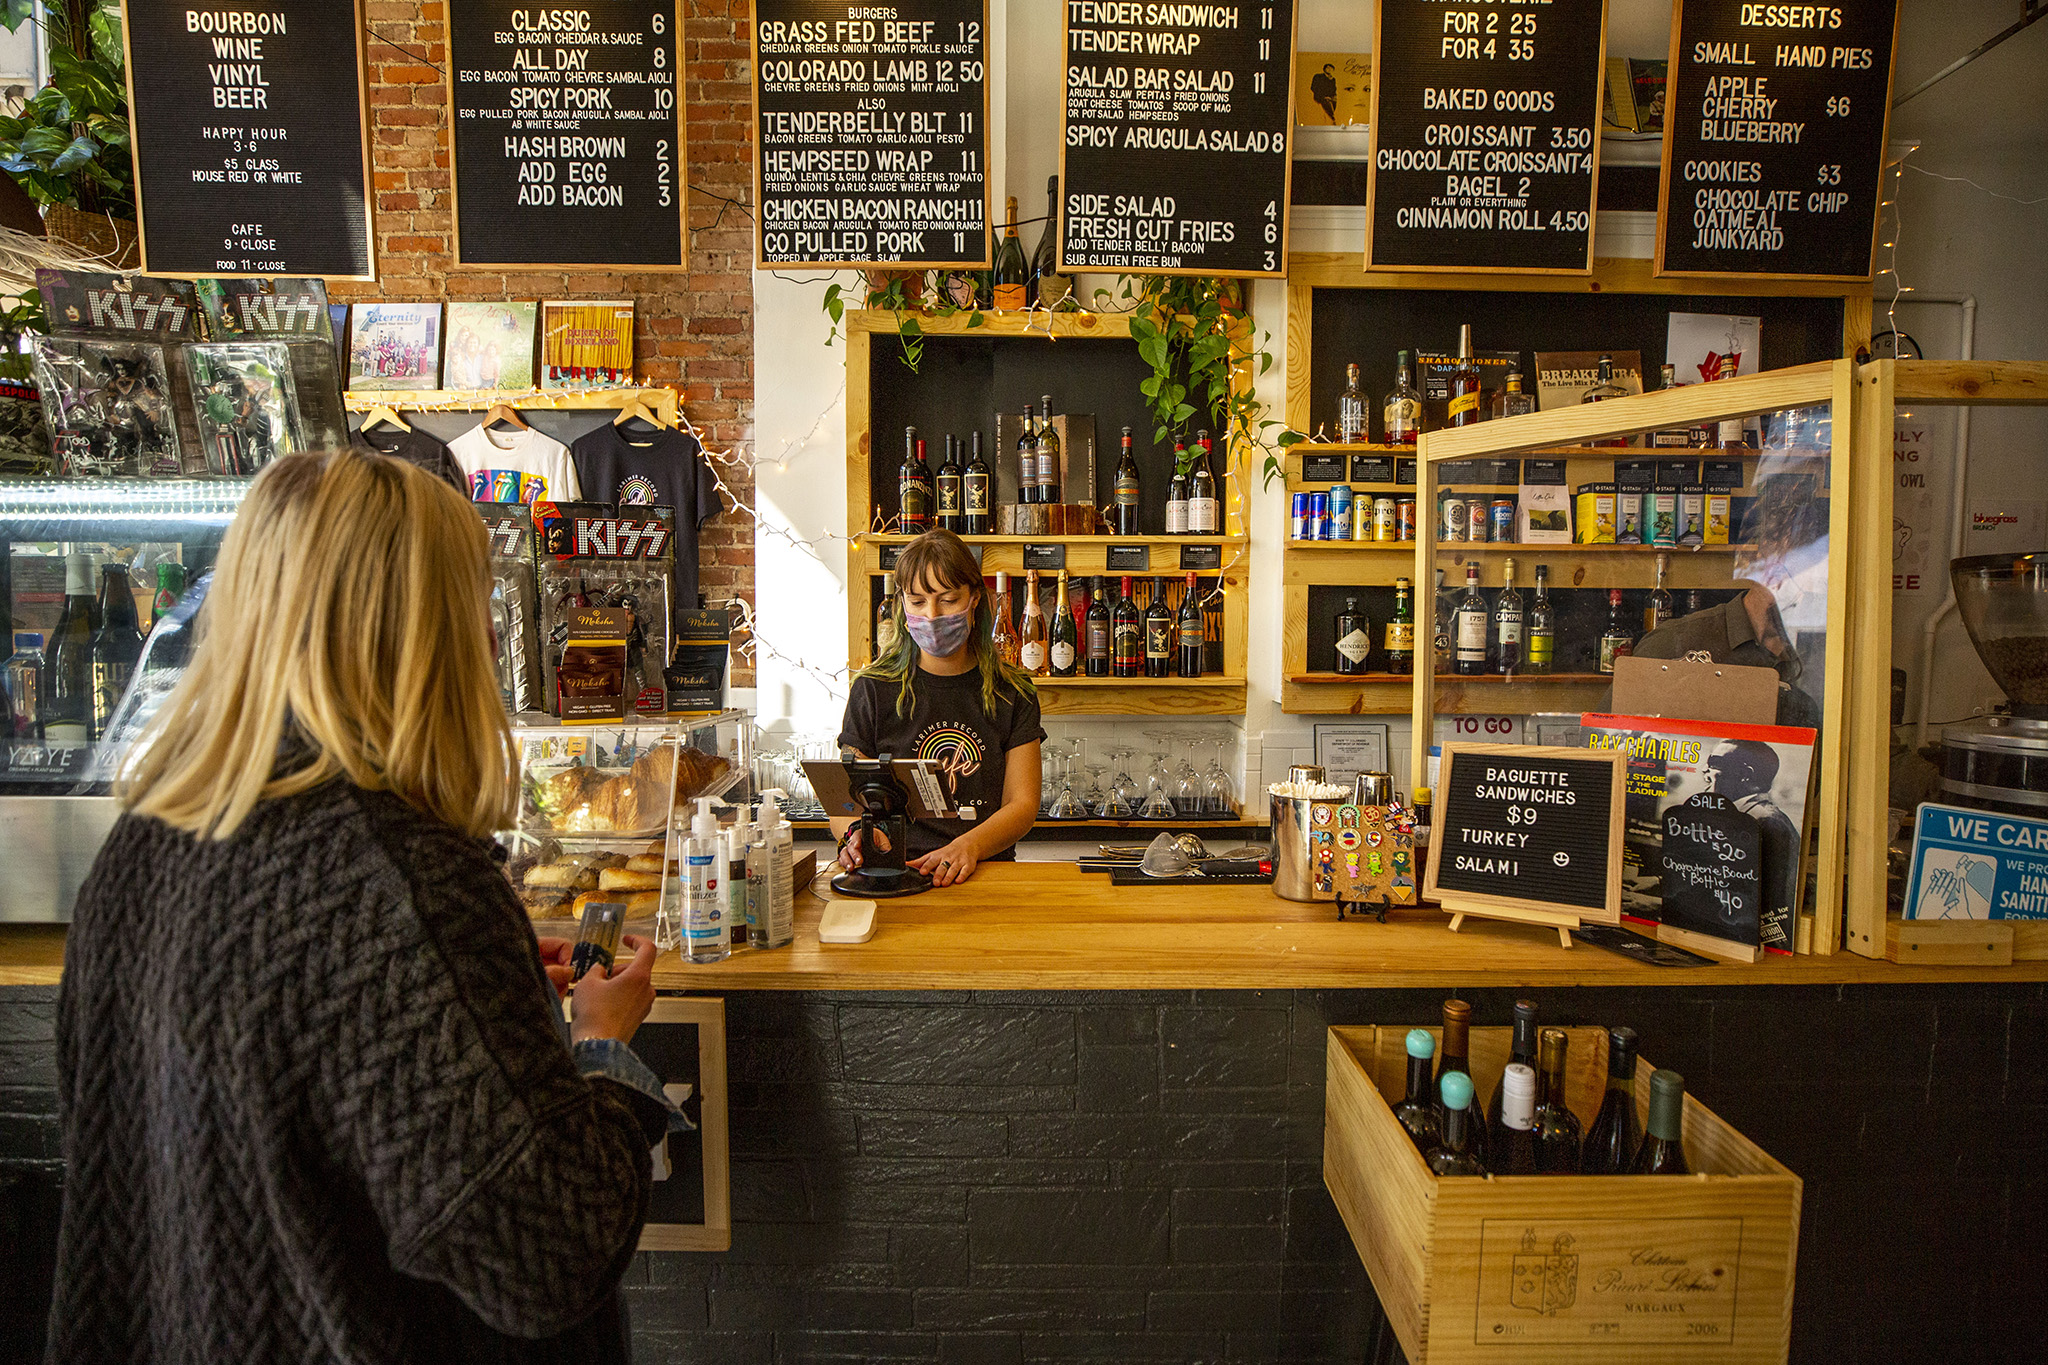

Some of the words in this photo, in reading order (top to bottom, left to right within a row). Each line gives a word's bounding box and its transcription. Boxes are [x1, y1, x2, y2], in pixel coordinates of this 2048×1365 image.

[186, 11, 286, 34] BOURBON
[512, 10, 590, 32] CLASSIC
[652, 13, 665, 34] 6
[848, 7, 897, 20] BURGERS
[1444, 11, 1479, 34] FOR
[1486, 12, 1498, 34] 2
[1510, 13, 1536, 35] 25
[1741, 4, 1842, 29] DESSERTS
[495, 32, 514, 43] EGG
[519, 33, 551, 44] BACON
[555, 33, 599, 44] CHEDDAR
[602, 33, 609, 44] &
[611, 33, 643, 44] SAUCE
[760, 21, 828, 43] GRASS
[836, 21, 875, 43] FED
[884, 21, 935, 43] BEEF
[958, 22, 980, 43] 12
[212, 38, 263, 60] WINE
[513, 49, 550, 70] ALL
[556, 49, 589, 70] DAY
[654, 47, 666, 68] 8
[760, 43, 801, 53] CHEDDAR
[805, 44, 838, 53] GREENS
[842, 44, 868, 53] ONION
[872, 44, 906, 54] TOMATO
[911, 44, 940, 54] PICKLE
[944, 45, 973, 54] SAUCE
[1693, 42, 1756, 65] SMALL
[1775, 45, 1826, 67] HAND
[1831, 47, 1872, 69] PIES
[209, 64, 269, 86] VINYL
[762, 60, 865, 82] COLORADO
[874, 61, 927, 82] LAMB
[936, 61, 953, 82] 12
[960, 61, 983, 82] 50
[1068, 66, 1129, 88] SALAD
[1134, 68, 1170, 90] BAR
[1173, 69, 1234, 93] SALAD
[1254, 72, 1265, 94] 11
[213, 87, 267, 109] BEER
[510, 87, 560, 109] SPICY
[564, 88, 612, 109] PORK
[654, 88, 673, 109] 10
[857, 99, 885, 110] ALSO
[1424, 88, 1487, 111] BAKED
[1494, 90, 1554, 112] GOODS
[1702, 98, 1777, 119] CHERRY
[1826, 96, 1850, 117] $6
[763, 112, 905, 133] TENDERBELLY
[911, 112, 946, 133] BLT
[960, 112, 972, 134] 11
[203, 128, 243, 139] HAPPY
[251, 129, 287, 140] HOUR
[505, 136, 555, 158] HASH
[560, 136, 625, 158] BROWN
[656, 139, 668, 160] 2
[224, 159, 238, 170] $5
[246, 160, 279, 170] GLASS
[518, 162, 555, 182] ADD
[569, 162, 607, 183] EGG
[658, 163, 670, 184] 2
[1684, 161, 1762, 182] COOKIES
[1818, 165, 1841, 185] $3
[193, 171, 225, 182] HOUSE
[228, 172, 248, 182] RED
[254, 172, 267, 183] OR
[271, 172, 302, 183] WHITE
[518, 185, 555, 205] ADD
[562, 185, 623, 206] BACON
[658, 186, 670, 207] 3
[1432, 197, 1455, 207] PLAIN
[1460, 198, 1471, 207] OR
[1475, 198, 1526, 208] EVERYTHING
[1695, 189, 1800, 211] CHOCOLATE
[1808, 192, 1849, 213] CHIP
[764, 199, 838, 220] CHICKEN
[842, 199, 899, 220] BACON
[904, 200, 966, 221] RANCH
[969, 200, 982, 221] 11
[1397, 207, 1493, 230] CINNAMON
[1499, 209, 1545, 231] ROLL
[1550, 211, 1589, 232] 4.50
[232, 224, 263, 235] CAFE
[1068, 217, 1130, 239] FRESH
[1136, 219, 1174, 241] CUT
[1179, 220, 1234, 243] FRIES
[1265, 223, 1277, 244] 6
[1066, 254, 1085, 265] SUB
[1089, 254, 1129, 266] GLUTEN
[1132, 256, 1158, 267] FREE
[1161, 256, 1181, 268] BUN
[1263, 251, 1275, 271] 3
[86, 289, 190, 333] KISS
[237, 293, 321, 333] KISS
[366, 309, 422, 324] Eternity
[565, 338, 618, 346] DIXIELAND
[567, 329, 602, 338] DUKES
[603, 329, 617, 337] OF
[1574, 379, 1587, 387] Mix
[1901, 474, 1925, 488] OWL
[1974, 513, 2018, 526] bluegrass
[577, 519, 666, 556] KISS
[1435, 636, 1448, 648] 43
[1454, 717, 1479, 734] TO
[1484, 717, 1513, 734] GO
[911, 721, 948, 752] LARIMER
[953, 721, 986, 752] RECORD
[1589, 733, 1622, 751] RAY
[1624, 736, 1701, 764] CHARLES
[1486, 768, 1569, 786] BAGUETTE
[1633, 773, 1666, 784] STAGE
[1665, 765, 1697, 773] LIVE
[1475, 785, 1576, 805] SANDWICHES
[1691, 795, 1726, 810] SALE
[1506, 805, 1537, 826] $9
[1461, 828, 1530, 848] TURKEY
[1668, 817, 1728, 843] Bottle
[1948, 816, 1989, 842] WE
[1712, 842, 1746, 861] $20
[1455, 856, 1519, 876] SALAMI
[1722, 867, 1758, 881] Board
[2006, 860, 2024, 871] WE
[1691, 872, 1729, 888] Bottle
[1714, 889, 1743, 915] $40
[1768, 913, 1788, 923] Time
[1624, 1302, 1686, 1313] MARGAUX
[1686, 1323, 1718, 1335] 2006
